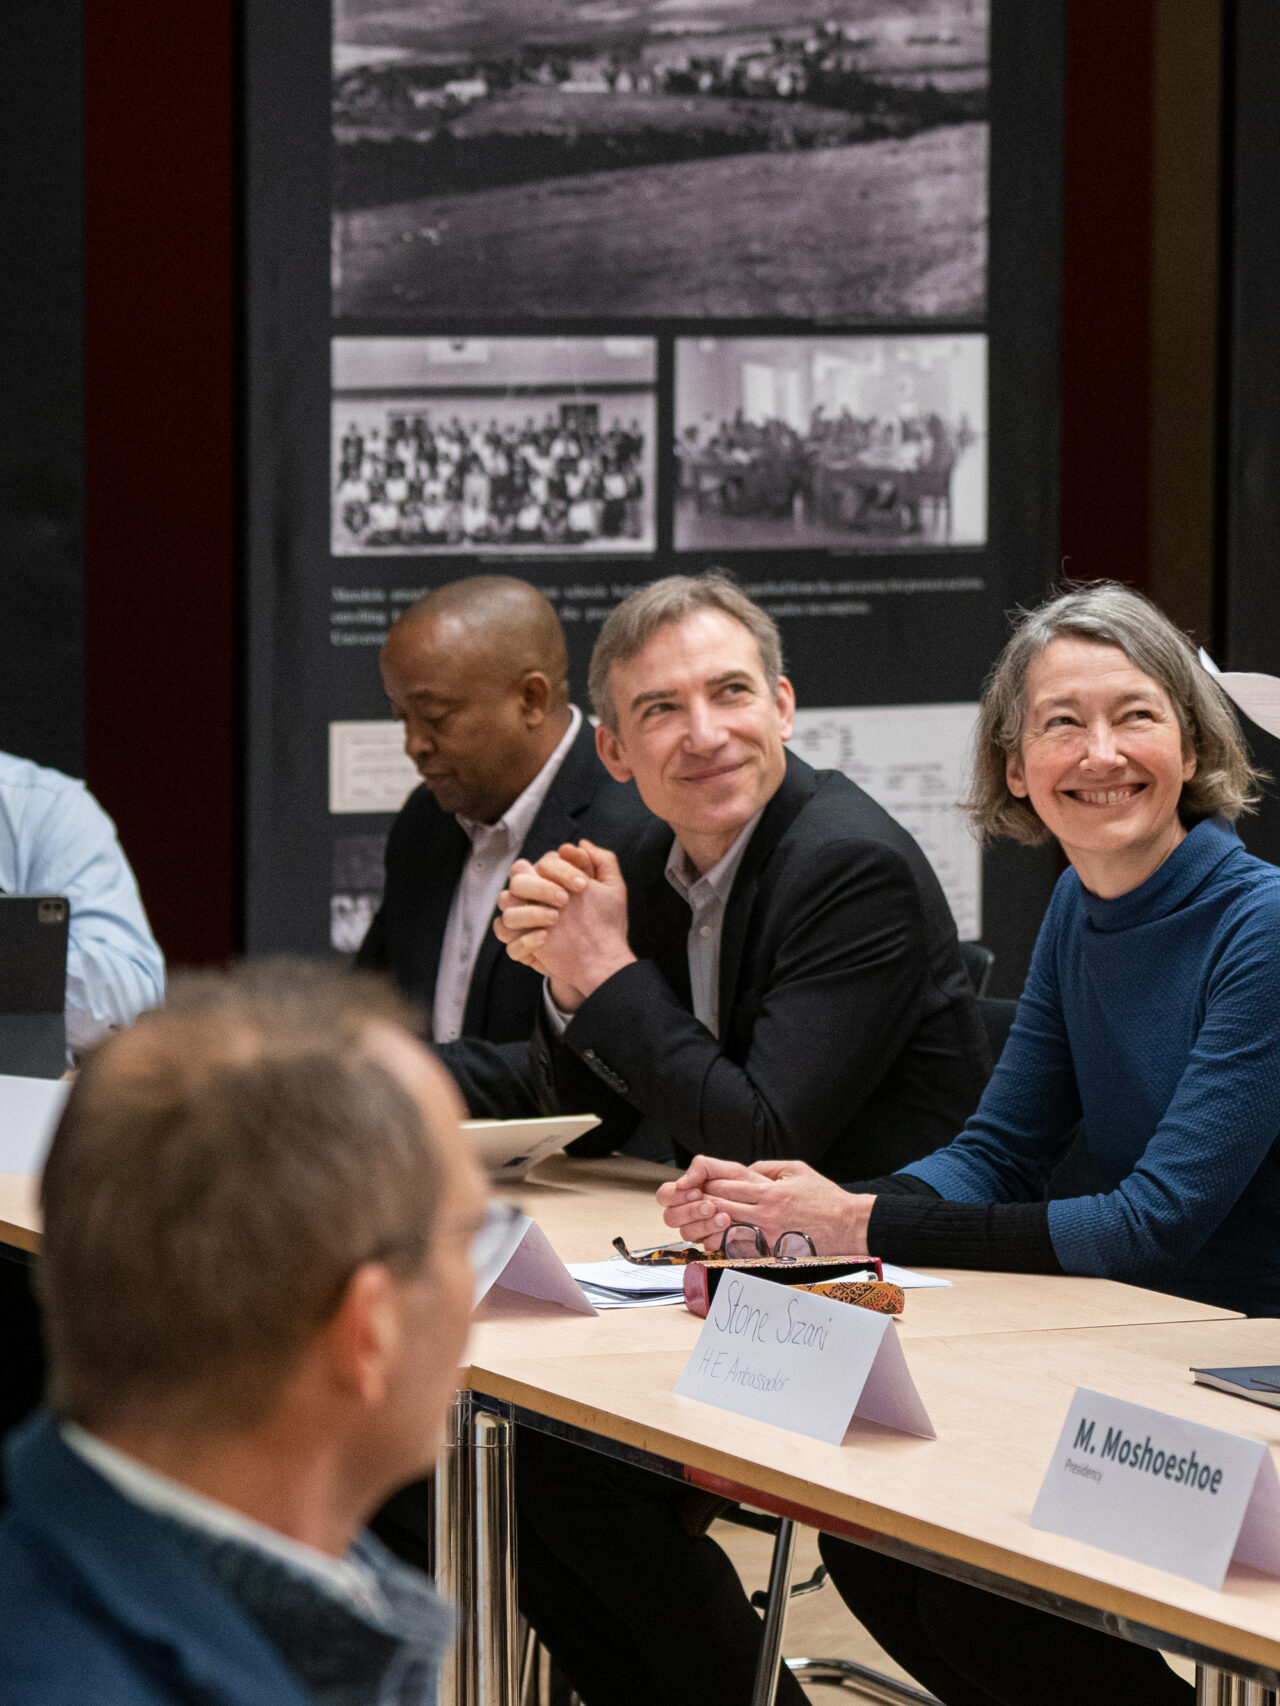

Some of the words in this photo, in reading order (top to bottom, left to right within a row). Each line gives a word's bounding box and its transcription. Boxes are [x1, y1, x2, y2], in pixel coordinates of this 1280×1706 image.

[715, 1280, 768, 1343] Stone
[776, 1299, 833, 1351] Sizani
[726, 1357, 790, 1392] Ambassador
[1073, 1418, 1096, 1455] M.
[1100, 1426, 1223, 1495] Moshoeshoe
